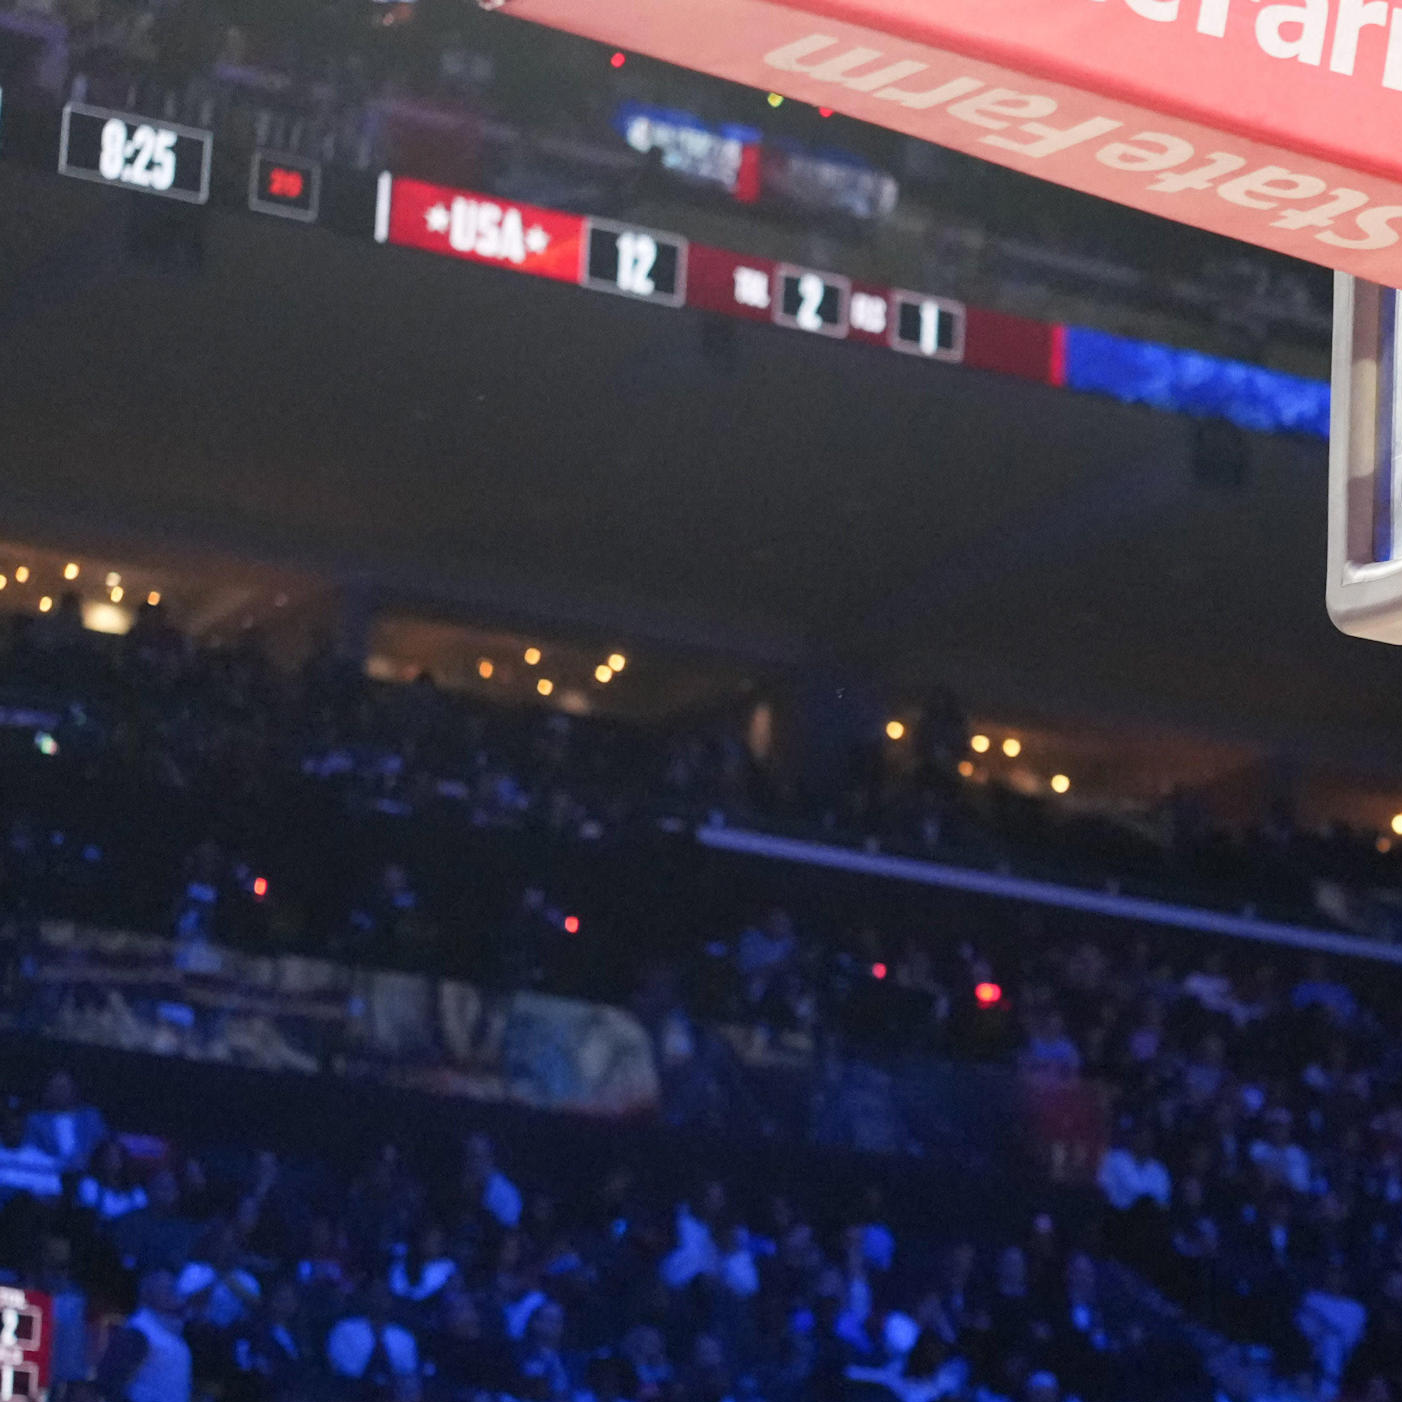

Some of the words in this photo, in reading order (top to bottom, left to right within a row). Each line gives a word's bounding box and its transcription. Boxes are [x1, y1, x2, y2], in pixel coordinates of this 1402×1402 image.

[449, 196, 527, 264] USA
[615, 231, 657, 296] 12
[798, 273, 824, 332] 2
